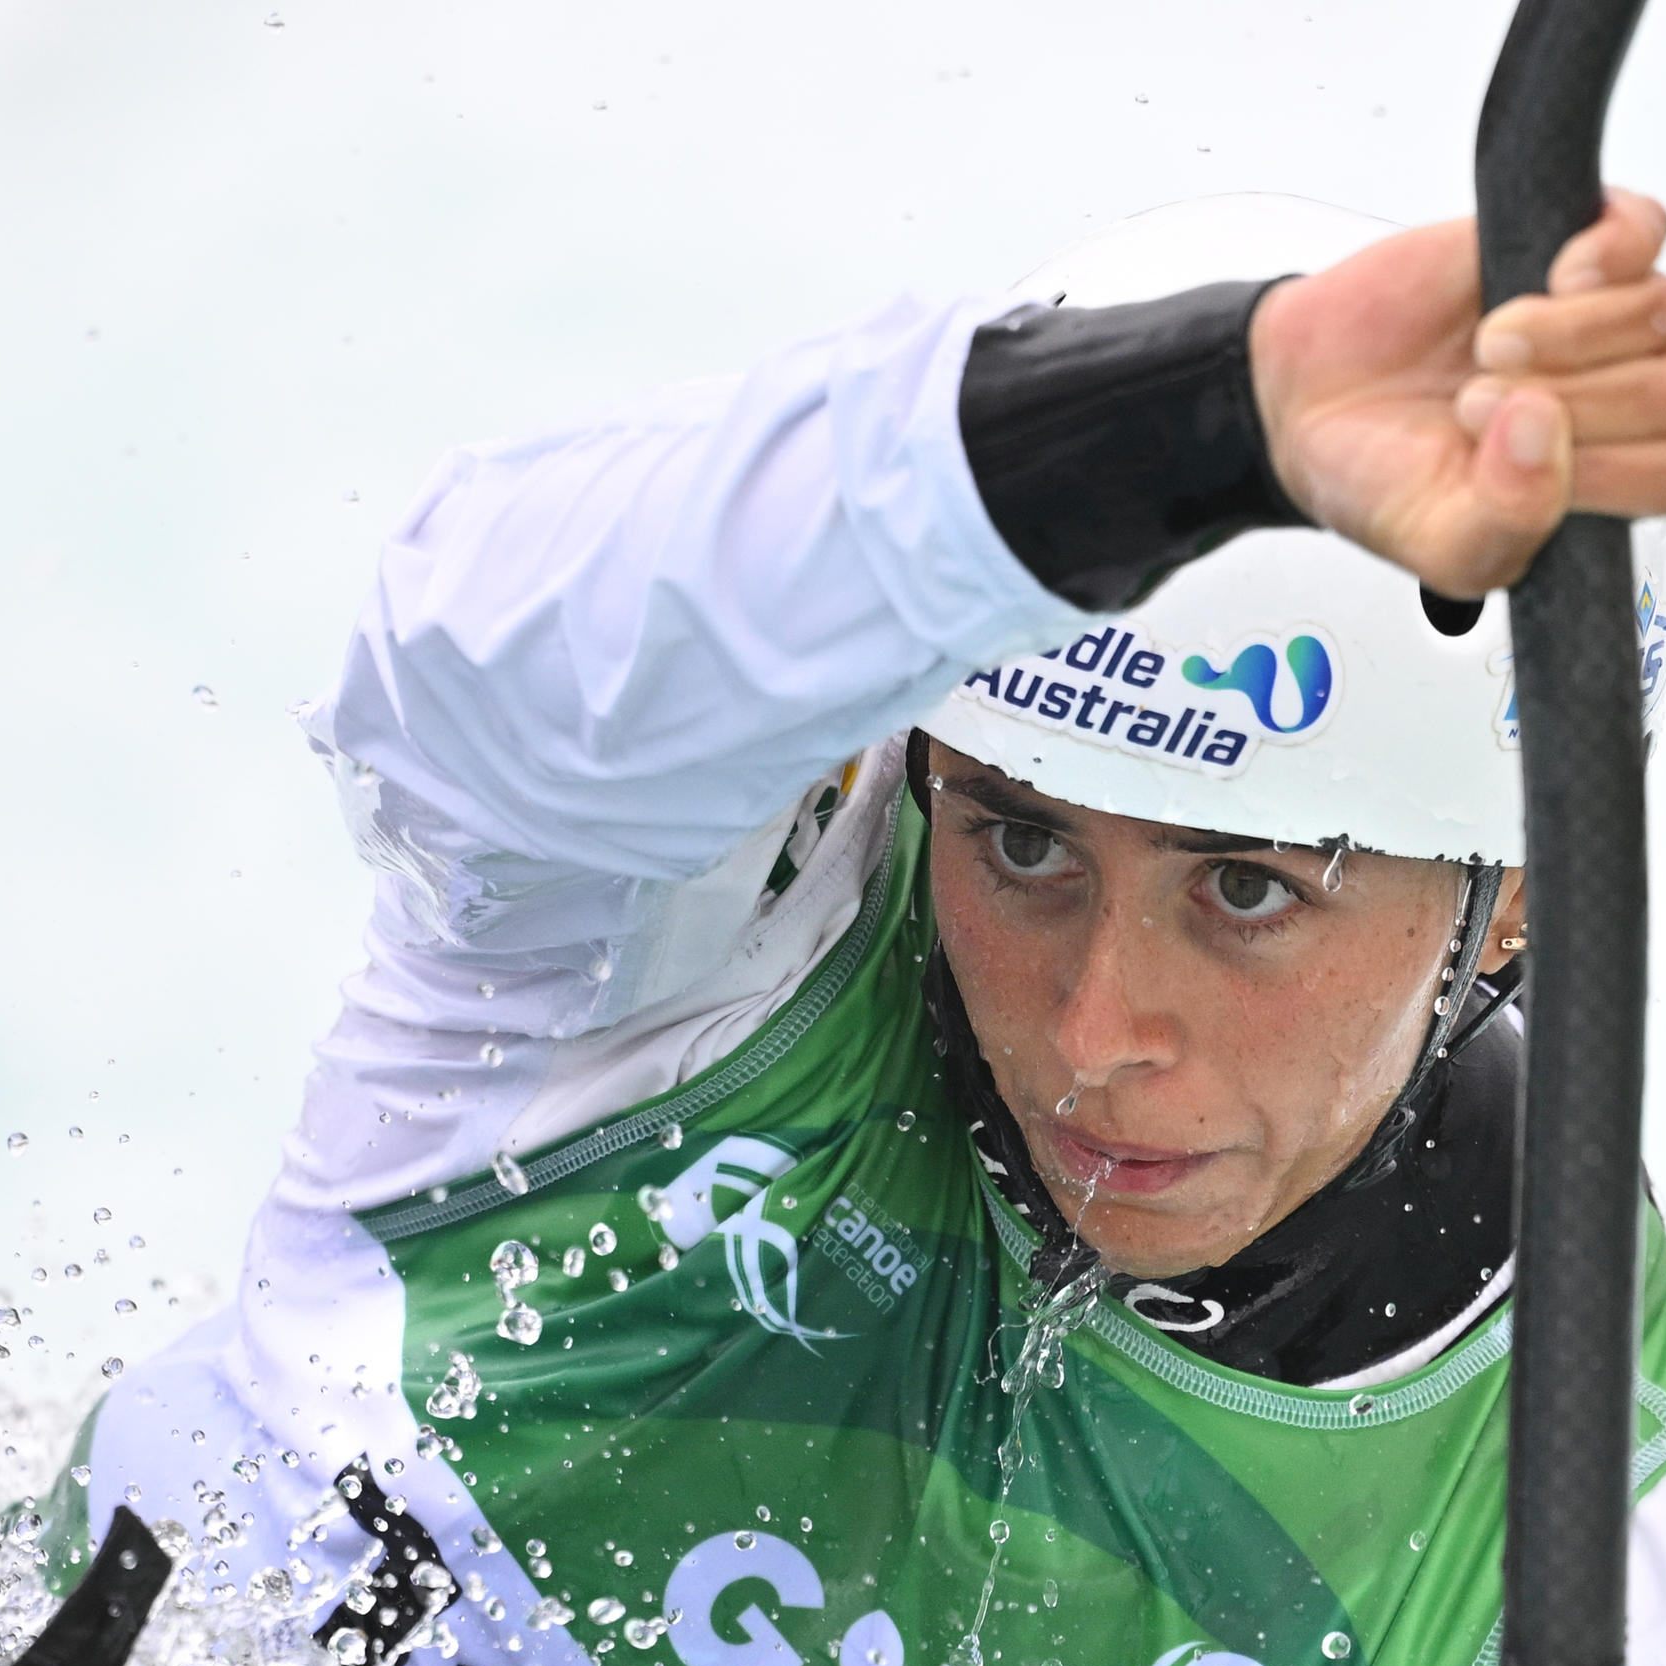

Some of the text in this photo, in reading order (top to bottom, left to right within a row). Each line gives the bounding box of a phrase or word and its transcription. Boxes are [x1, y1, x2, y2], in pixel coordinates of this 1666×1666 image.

[964, 666, 1247, 766] Australia
[824, 1196, 918, 1296] canoe
[844, 1182, 935, 1273] nternational
